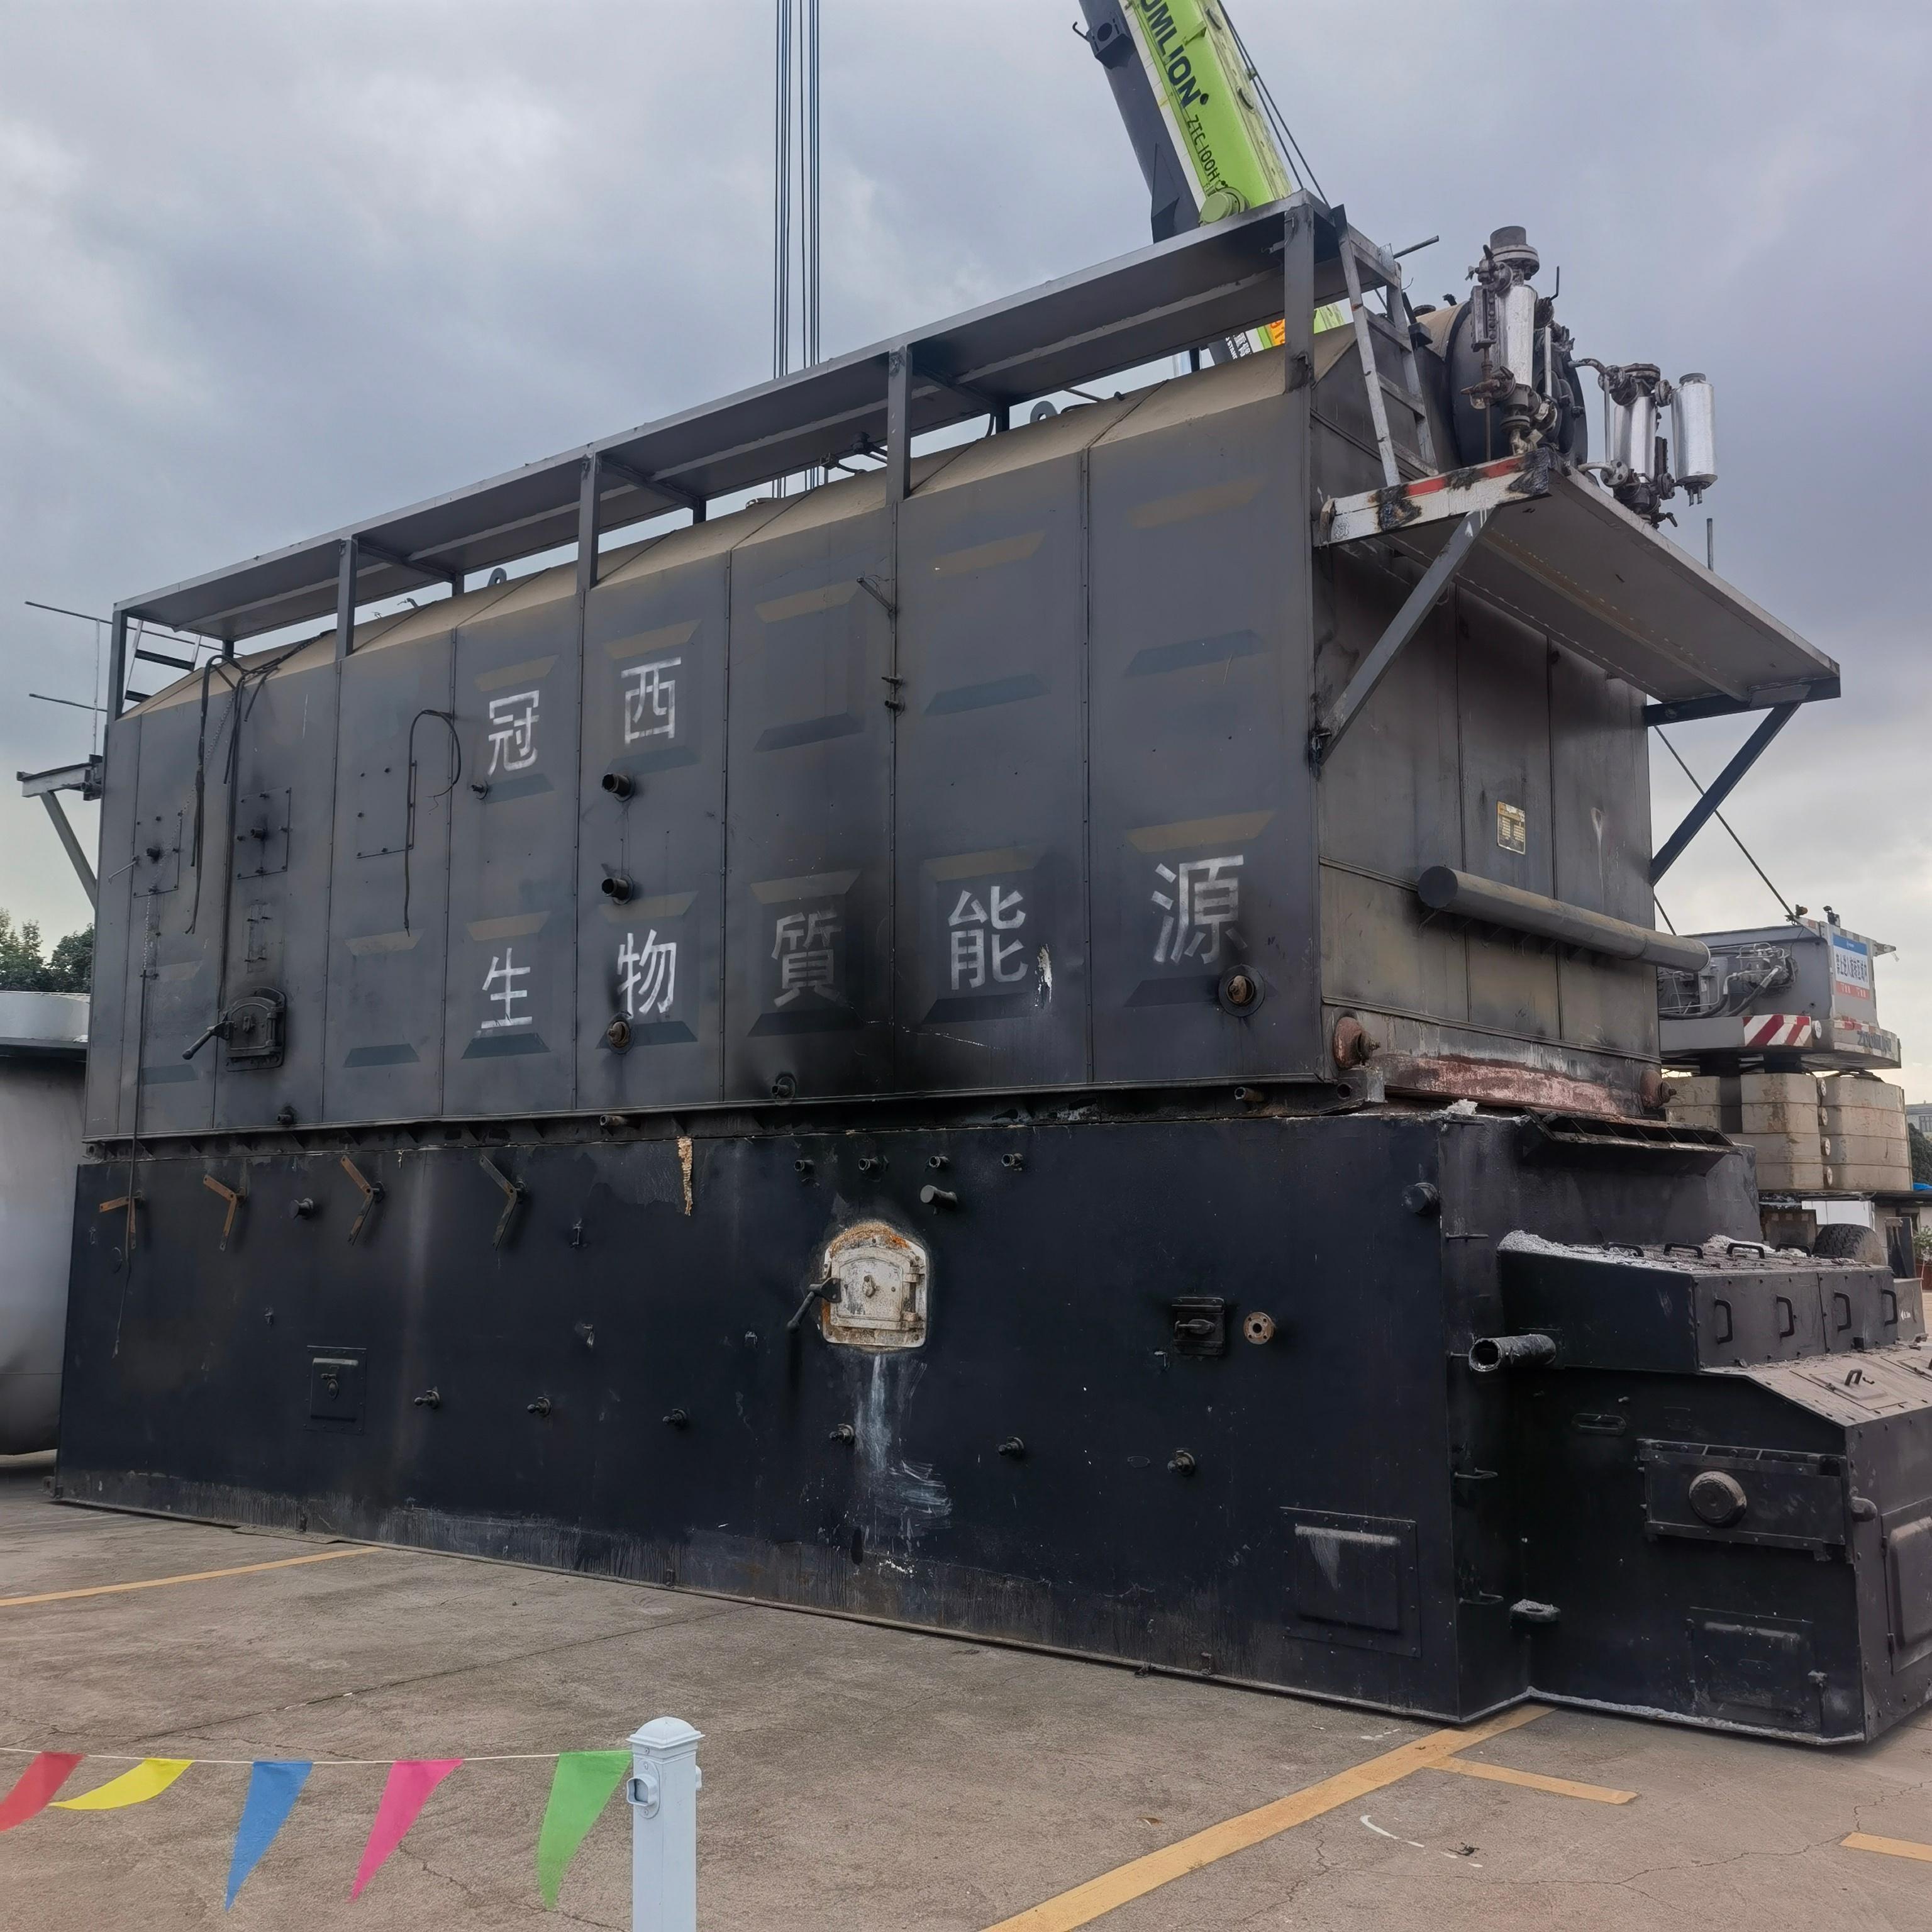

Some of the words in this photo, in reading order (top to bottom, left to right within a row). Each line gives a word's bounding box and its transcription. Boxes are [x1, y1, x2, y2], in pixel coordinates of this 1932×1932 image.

[1233, 332, 1251, 357] 重臂
[487, 657, 682, 775] 冠西
[481, 854, 1248, 1029] 生物質能源
